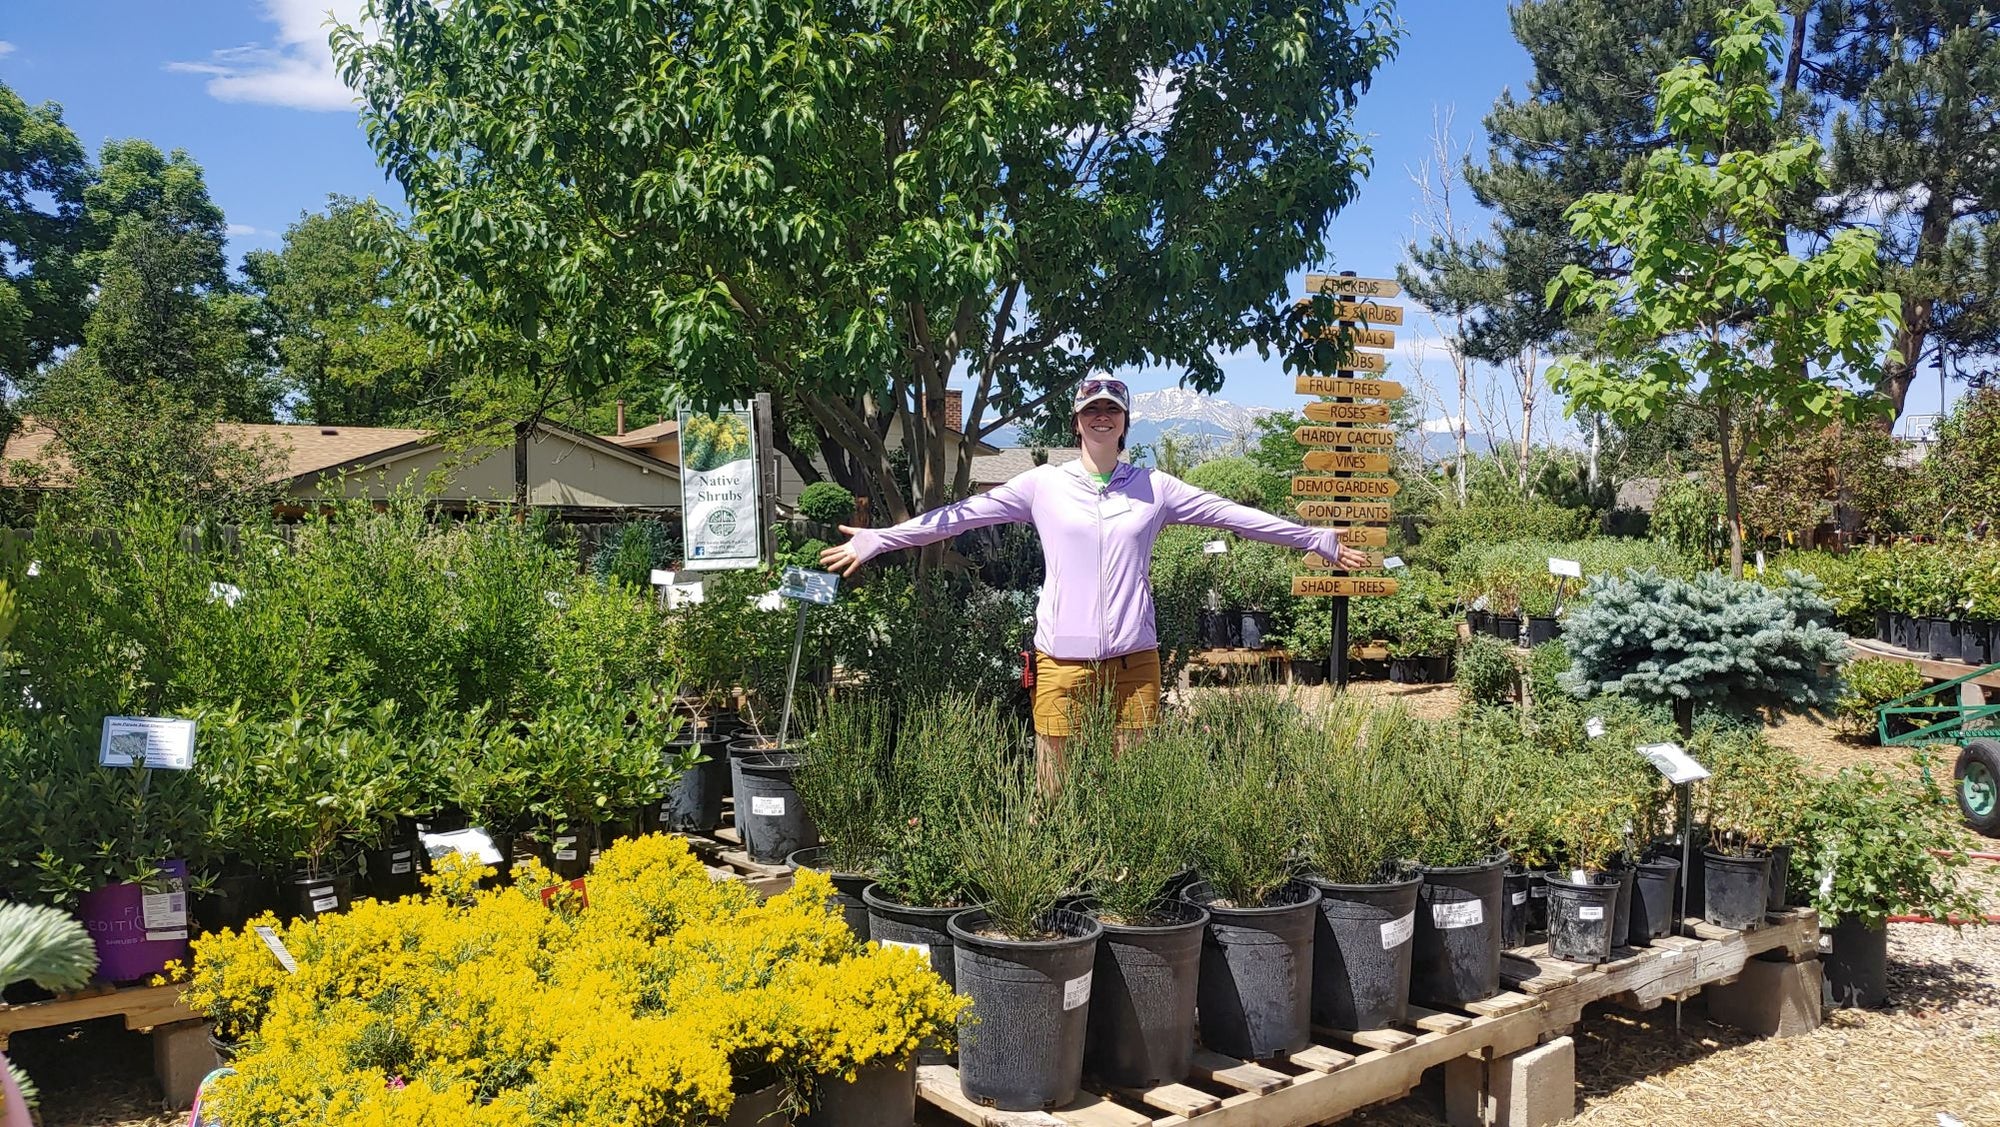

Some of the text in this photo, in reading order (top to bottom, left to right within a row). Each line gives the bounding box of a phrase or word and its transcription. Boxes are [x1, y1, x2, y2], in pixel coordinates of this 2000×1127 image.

[1309, 380, 1381, 396] FRUIT TREES
[1330, 406, 1366, 419] ROSES
[1301, 429, 1393, 445] HARDY CACTUS
[1335, 455, 1366, 469] VINES
[700, 475, 740, 487] Native
[1296, 480, 1389, 494] DEMO GARDENS
[698, 490, 742, 502] Shrubs
[1308, 505, 1388, 519] POND PLANTS
[1300, 580, 1385, 594] SHADE TREES
